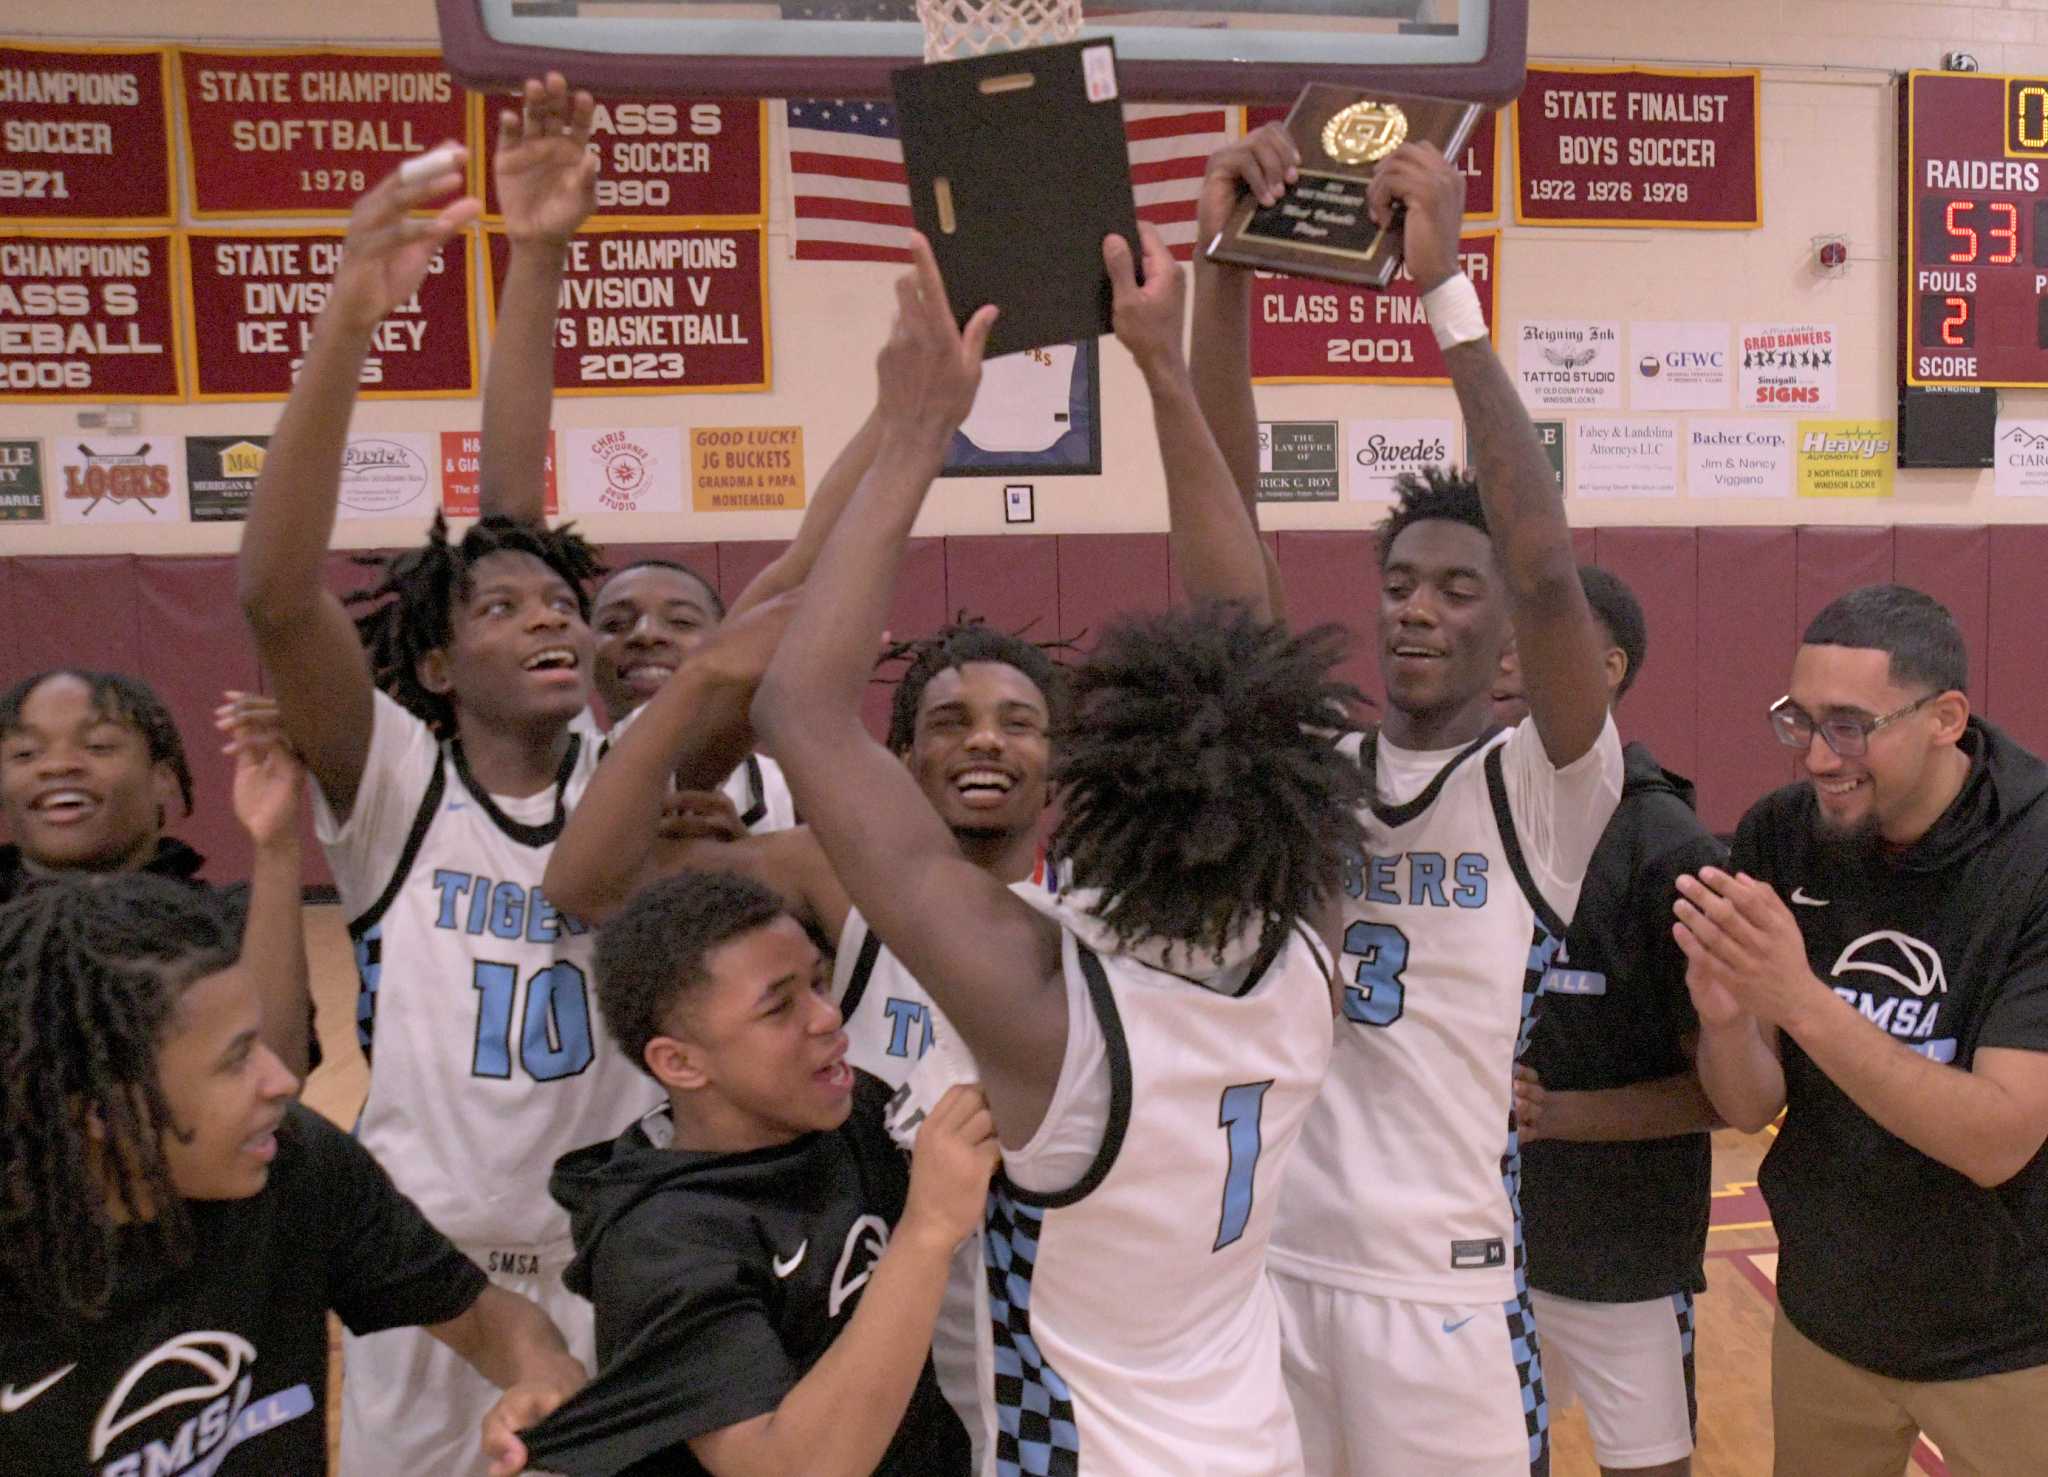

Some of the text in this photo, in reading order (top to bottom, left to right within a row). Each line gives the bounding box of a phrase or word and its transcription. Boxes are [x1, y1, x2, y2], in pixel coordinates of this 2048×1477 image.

[200, 70, 452, 104] STATE CHAMPIONS
[690, 104, 722, 135] S
[1544, 90, 1729, 123] STATE FINALIST
[4, 120, 113, 155] SOCCER
[233, 120, 425, 152] SOFTBALL
[613, 142, 711, 174] SOCCER
[1559, 135, 1716, 168] BOYS SOCCER
[300, 170, 366, 192] 1978
[1926, 159, 2040, 192] RAIDERS
[595, 179, 670, 207] 990
[1530, 179, 1689, 203] 1972 1976 1978
[1946, 201, 2017, 263] 53
[2, 245, 151, 278] CHAMPIONS
[215, 243, 301, 276] STATE
[601, 238, 737, 271] CHAMPIONS
[688, 276, 712, 307] V
[1919, 271, 1977, 293] FOULS
[103, 283, 139, 316] S
[246, 282, 333, 314] DIVIS
[1263, 294, 1432, 325] CLASS S FINA
[587, 314, 749, 348] BASKETBALL
[1589, 326, 1615, 341] Ink
[1942, 297, 1967, 345] 2
[237, 321, 290, 353] ICE
[1327, 339, 1415, 364] 2001
[1743, 330, 1832, 351] GRAD BANNERS
[580, 353, 686, 382] 2023
[1666, 351, 1724, 367] GFWC
[1919, 356, 1978, 377] SCORE
[1523, 371, 1616, 383] TATTOO STUDIO
[592, 430, 625, 454] CHRIS
[696, 430, 798, 446] GOOD LUCK!
[1293, 433, 1315, 442] THE
[1611, 426, 1622, 439] &
[1693, 431, 1786, 448] Bacher Corp.
[1801, 431, 1891, 460] Heavys
[702, 450, 792, 469] JG BUCKETS
[1274, 443, 1333, 452] LAW OFFICE
[1297, 453, 1310, 461] OF
[1356, 434, 1446, 466] Swede's
[1590, 443, 1638, 457] Attorneys
[2009, 454, 2048, 467] CIAR
[1701, 458, 1777, 471] Jim & Nancy
[63, 464, 171, 499] LOCKS
[698, 476, 753, 488] GRANDMA
[768, 475, 797, 487] PAPA
[1308, 477, 1332, 488] ROY
[599, 494, 637, 511] STUDIO
[433, 868, 588, 944] TIGE
[1342, 919, 1410, 1028] 3
[471, 957, 596, 1083] 10
[1211, 1078, 1276, 1255] 1
[488, 1251, 539, 1275] SMSA
